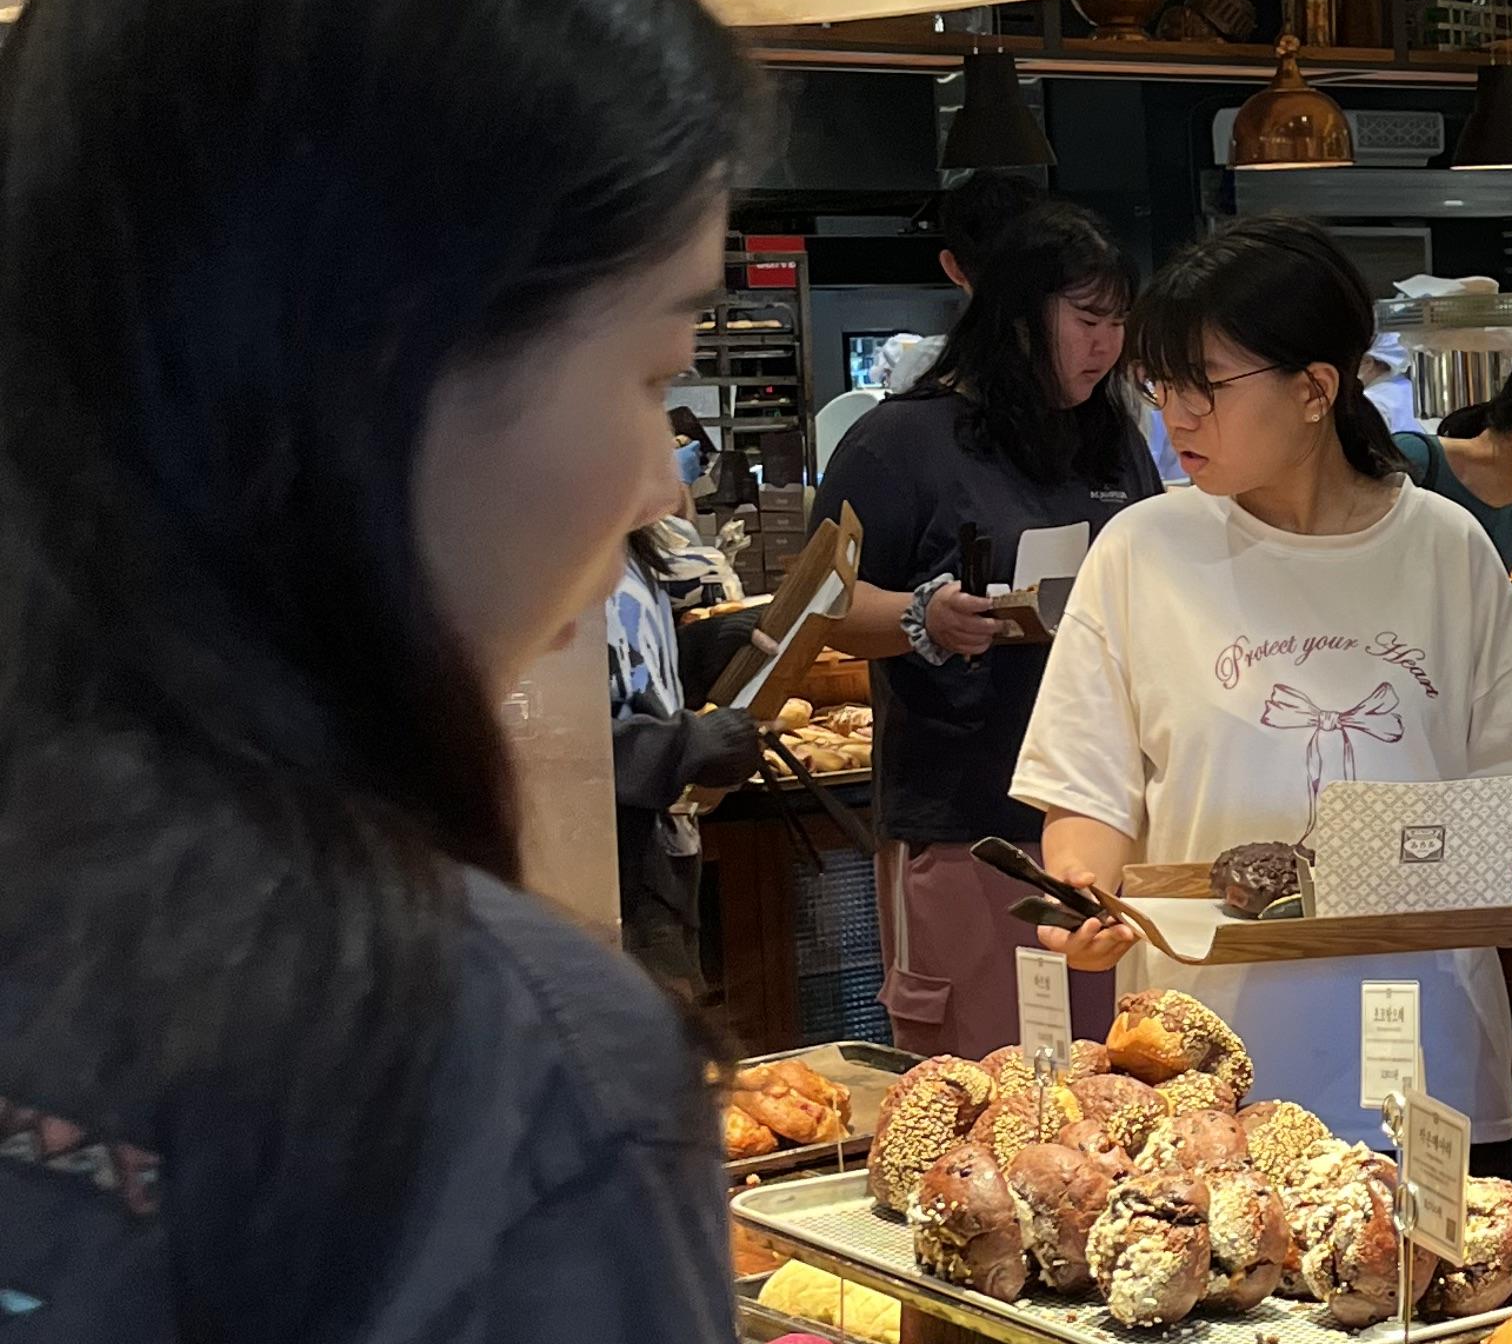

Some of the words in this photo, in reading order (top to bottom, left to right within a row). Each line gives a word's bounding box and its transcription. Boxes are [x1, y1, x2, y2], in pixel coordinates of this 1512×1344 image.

[1215, 635, 1298, 690] Protect
[1295, 636, 1358, 666] your
[1365, 631, 1439, 699] Heart
